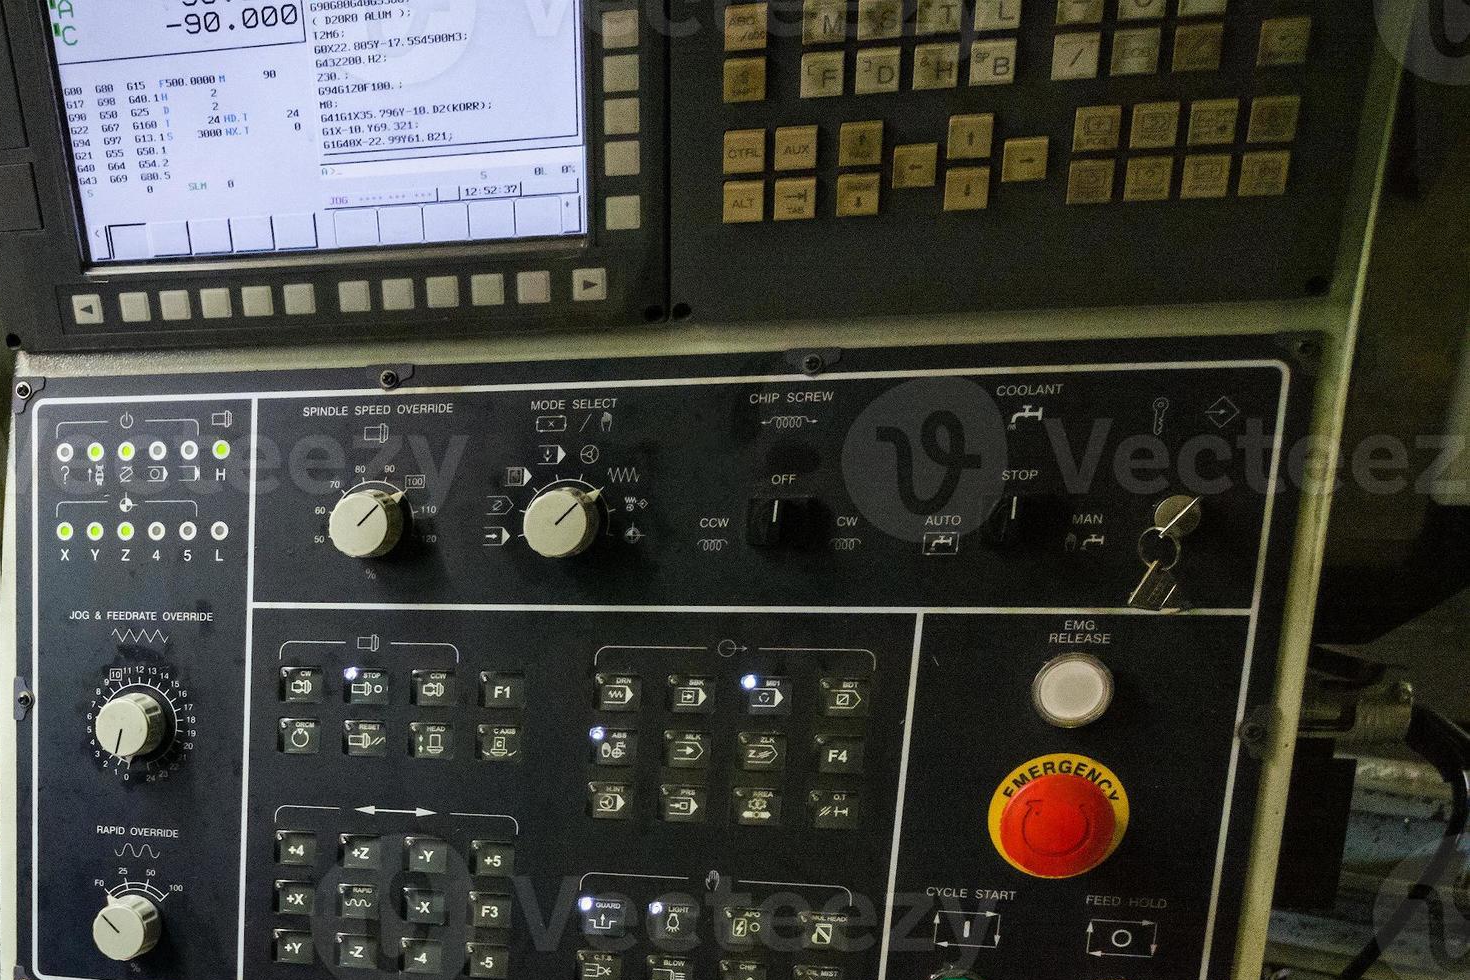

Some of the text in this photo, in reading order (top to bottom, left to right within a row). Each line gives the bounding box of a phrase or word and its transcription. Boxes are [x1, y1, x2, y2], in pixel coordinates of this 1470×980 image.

[58, 0, 74, 19] A
[364, 11, 392, 21] ALUM
[62, 4, 298, 46] C -90.000
[994, 57, 1010, 76] B
[127, 81, 145, 91] G15
[263, 70, 276, 79] 90
[66, 100, 84, 109] G17
[211, 88, 217, 98] 2
[131, 108, 150, 117] G25
[212, 102, 219, 111] 2
[70, 126, 89, 135] G22
[101, 123, 120, 133] G67
[208, 115, 220, 125] 24
[286, 109, 300, 119] 24
[73, 139, 91, 148] G94
[103, 136, 122, 146] G97
[197, 129, 223, 139] 3000
[294, 122, 301, 131] 0
[75, 152, 93, 160] G21
[106, 149, 124, 159] G55
[783, 144, 811, 156] AUX
[108, 162, 126, 171] G64
[138, 159, 169, 169] G54.2
[79, 177, 98, 186] G43
[110, 174, 128, 184] G69
[465, 185, 517, 196] 12:52:37
[732, 198, 755, 210] ALT
[996, 383, 1065, 396] COOLANT
[749, 391, 834, 404] CHIP SCREW
[303, 403, 454, 417] SPINDLE SPEED OVERRIDE
[531, 398, 618, 411] MODE SELECT
[215, 468, 226, 481] H
[355, 465, 395, 473] 80 90
[771, 474, 797, 485] OFF
[1002, 469, 1039, 482] STOP
[330, 480, 340, 489] 70
[314, 506, 436, 515] 60 110
[699, 517, 729, 528] CCW
[836, 516, 859, 527] CW
[925, 514, 962, 526] AUTO
[1072, 514, 1103, 525] MAN
[314, 535, 325, 544] 50
[60, 549, 223, 562] X Y Z 4 5 L
[69, 611, 214, 621] JOG & FEEDRATE OVERRIDE
[1064, 619, 1098, 631] EMG.
[1049, 633, 1111, 644] RELEASE
[135, 666, 145, 674] 12
[148, 667, 157, 675] 13
[160, 672, 169, 680] 14
[178, 690, 188, 698] 16
[495, 687, 511, 698] F1
[359, 723, 380, 731] RESET
[828, 750, 847, 763] F4
[1002, 759, 1120, 802] EMERGENCY
[96, 825, 179, 838] RAPID OVERRIDE
[288, 845, 304, 856] +4
[352, 847, 370, 859] +Z
[418, 851, 434, 863] -Y
[484, 855, 502, 867] +5
[146, 869, 156, 877] 50
[169, 884, 184, 892] 100
[926, 886, 1017, 901] CYCLE START
[286, 893, 304, 905] +X
[1086, 894, 1168, 910] FEED HOLD
[416, 902, 430, 913] -X
[482, 906, 499, 918] F3
[284, 943, 303, 954] +Y
[349, 946, 364, 958] -Z
[413, 953, 428, 964] -4
[480, 956, 494, 969] -5
